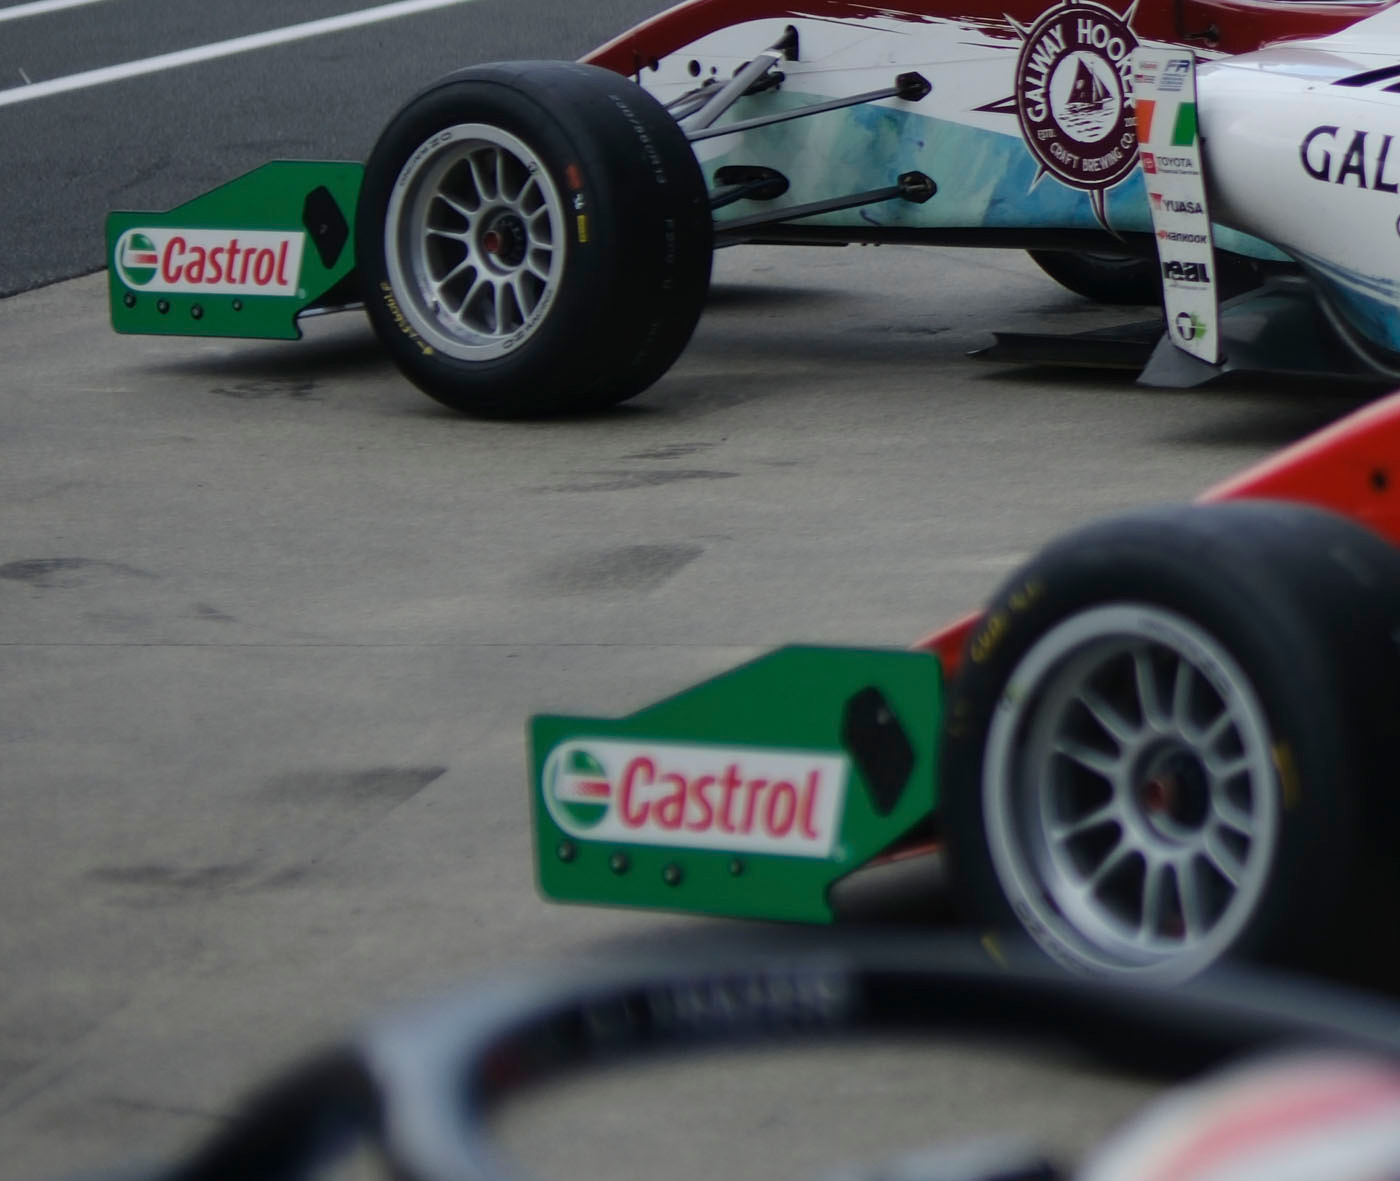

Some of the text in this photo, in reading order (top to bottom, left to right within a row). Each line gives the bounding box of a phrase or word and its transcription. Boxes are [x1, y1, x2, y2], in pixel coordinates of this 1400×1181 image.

[1024, 23, 1068, 123] GALWAY
[1050, 142, 1081, 169] CRAFT
[1083, 146, 1124, 172] BREWING
[1156, 156, 1193, 168] TOYOTA
[1163, 199, 1204, 215] YUASA
[161, 236, 289, 286] Castrol
[616, 755, 822, 840] Castrol
